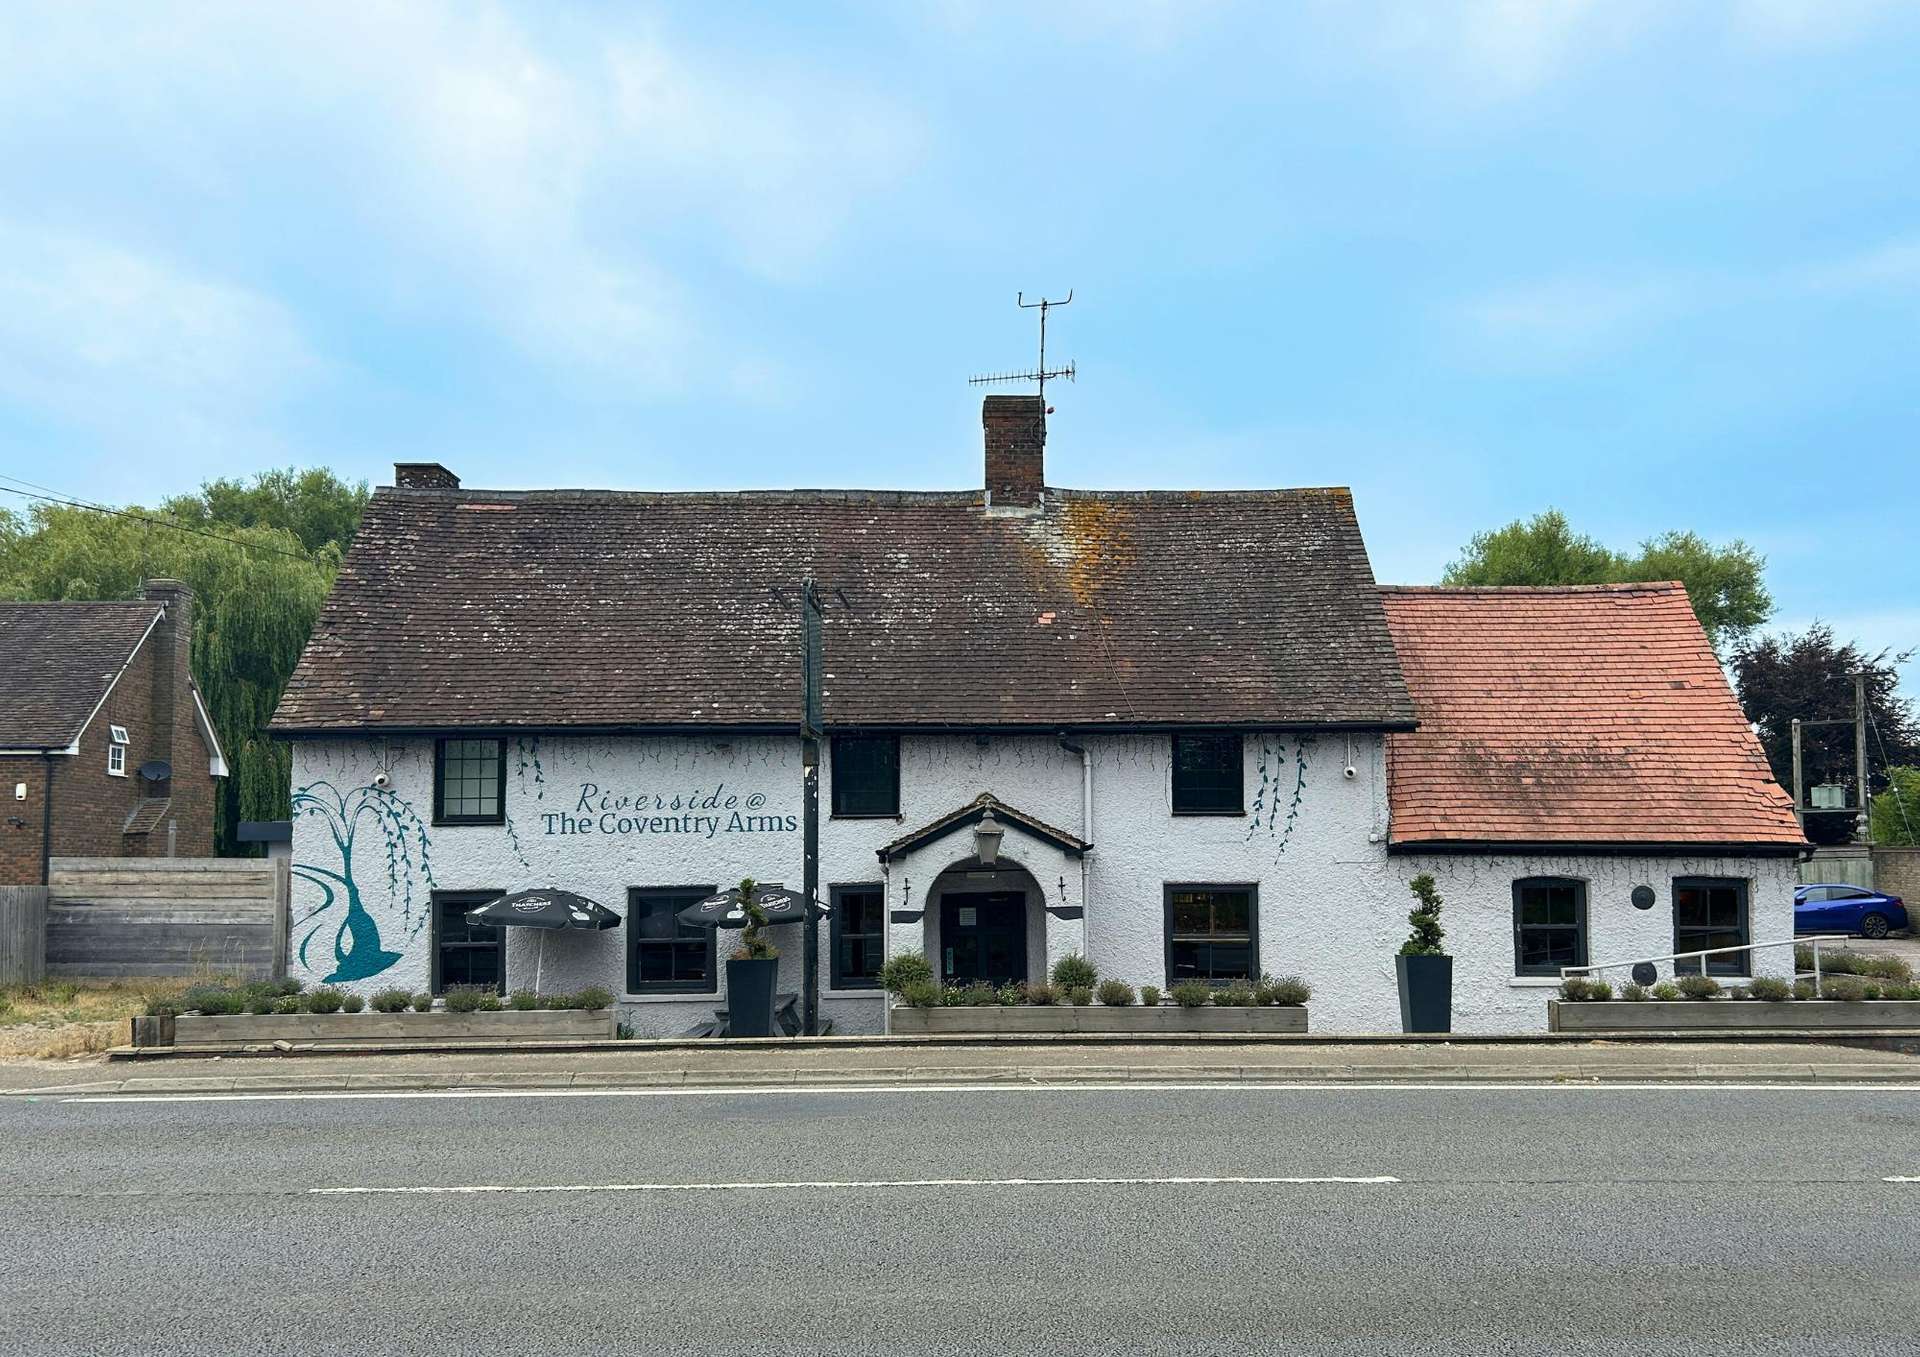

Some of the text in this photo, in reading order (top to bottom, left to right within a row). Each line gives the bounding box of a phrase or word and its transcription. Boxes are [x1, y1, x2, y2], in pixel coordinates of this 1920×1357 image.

[577, 783, 767, 813] Riverside @
[541, 811, 797, 839] The Coventry Arms
